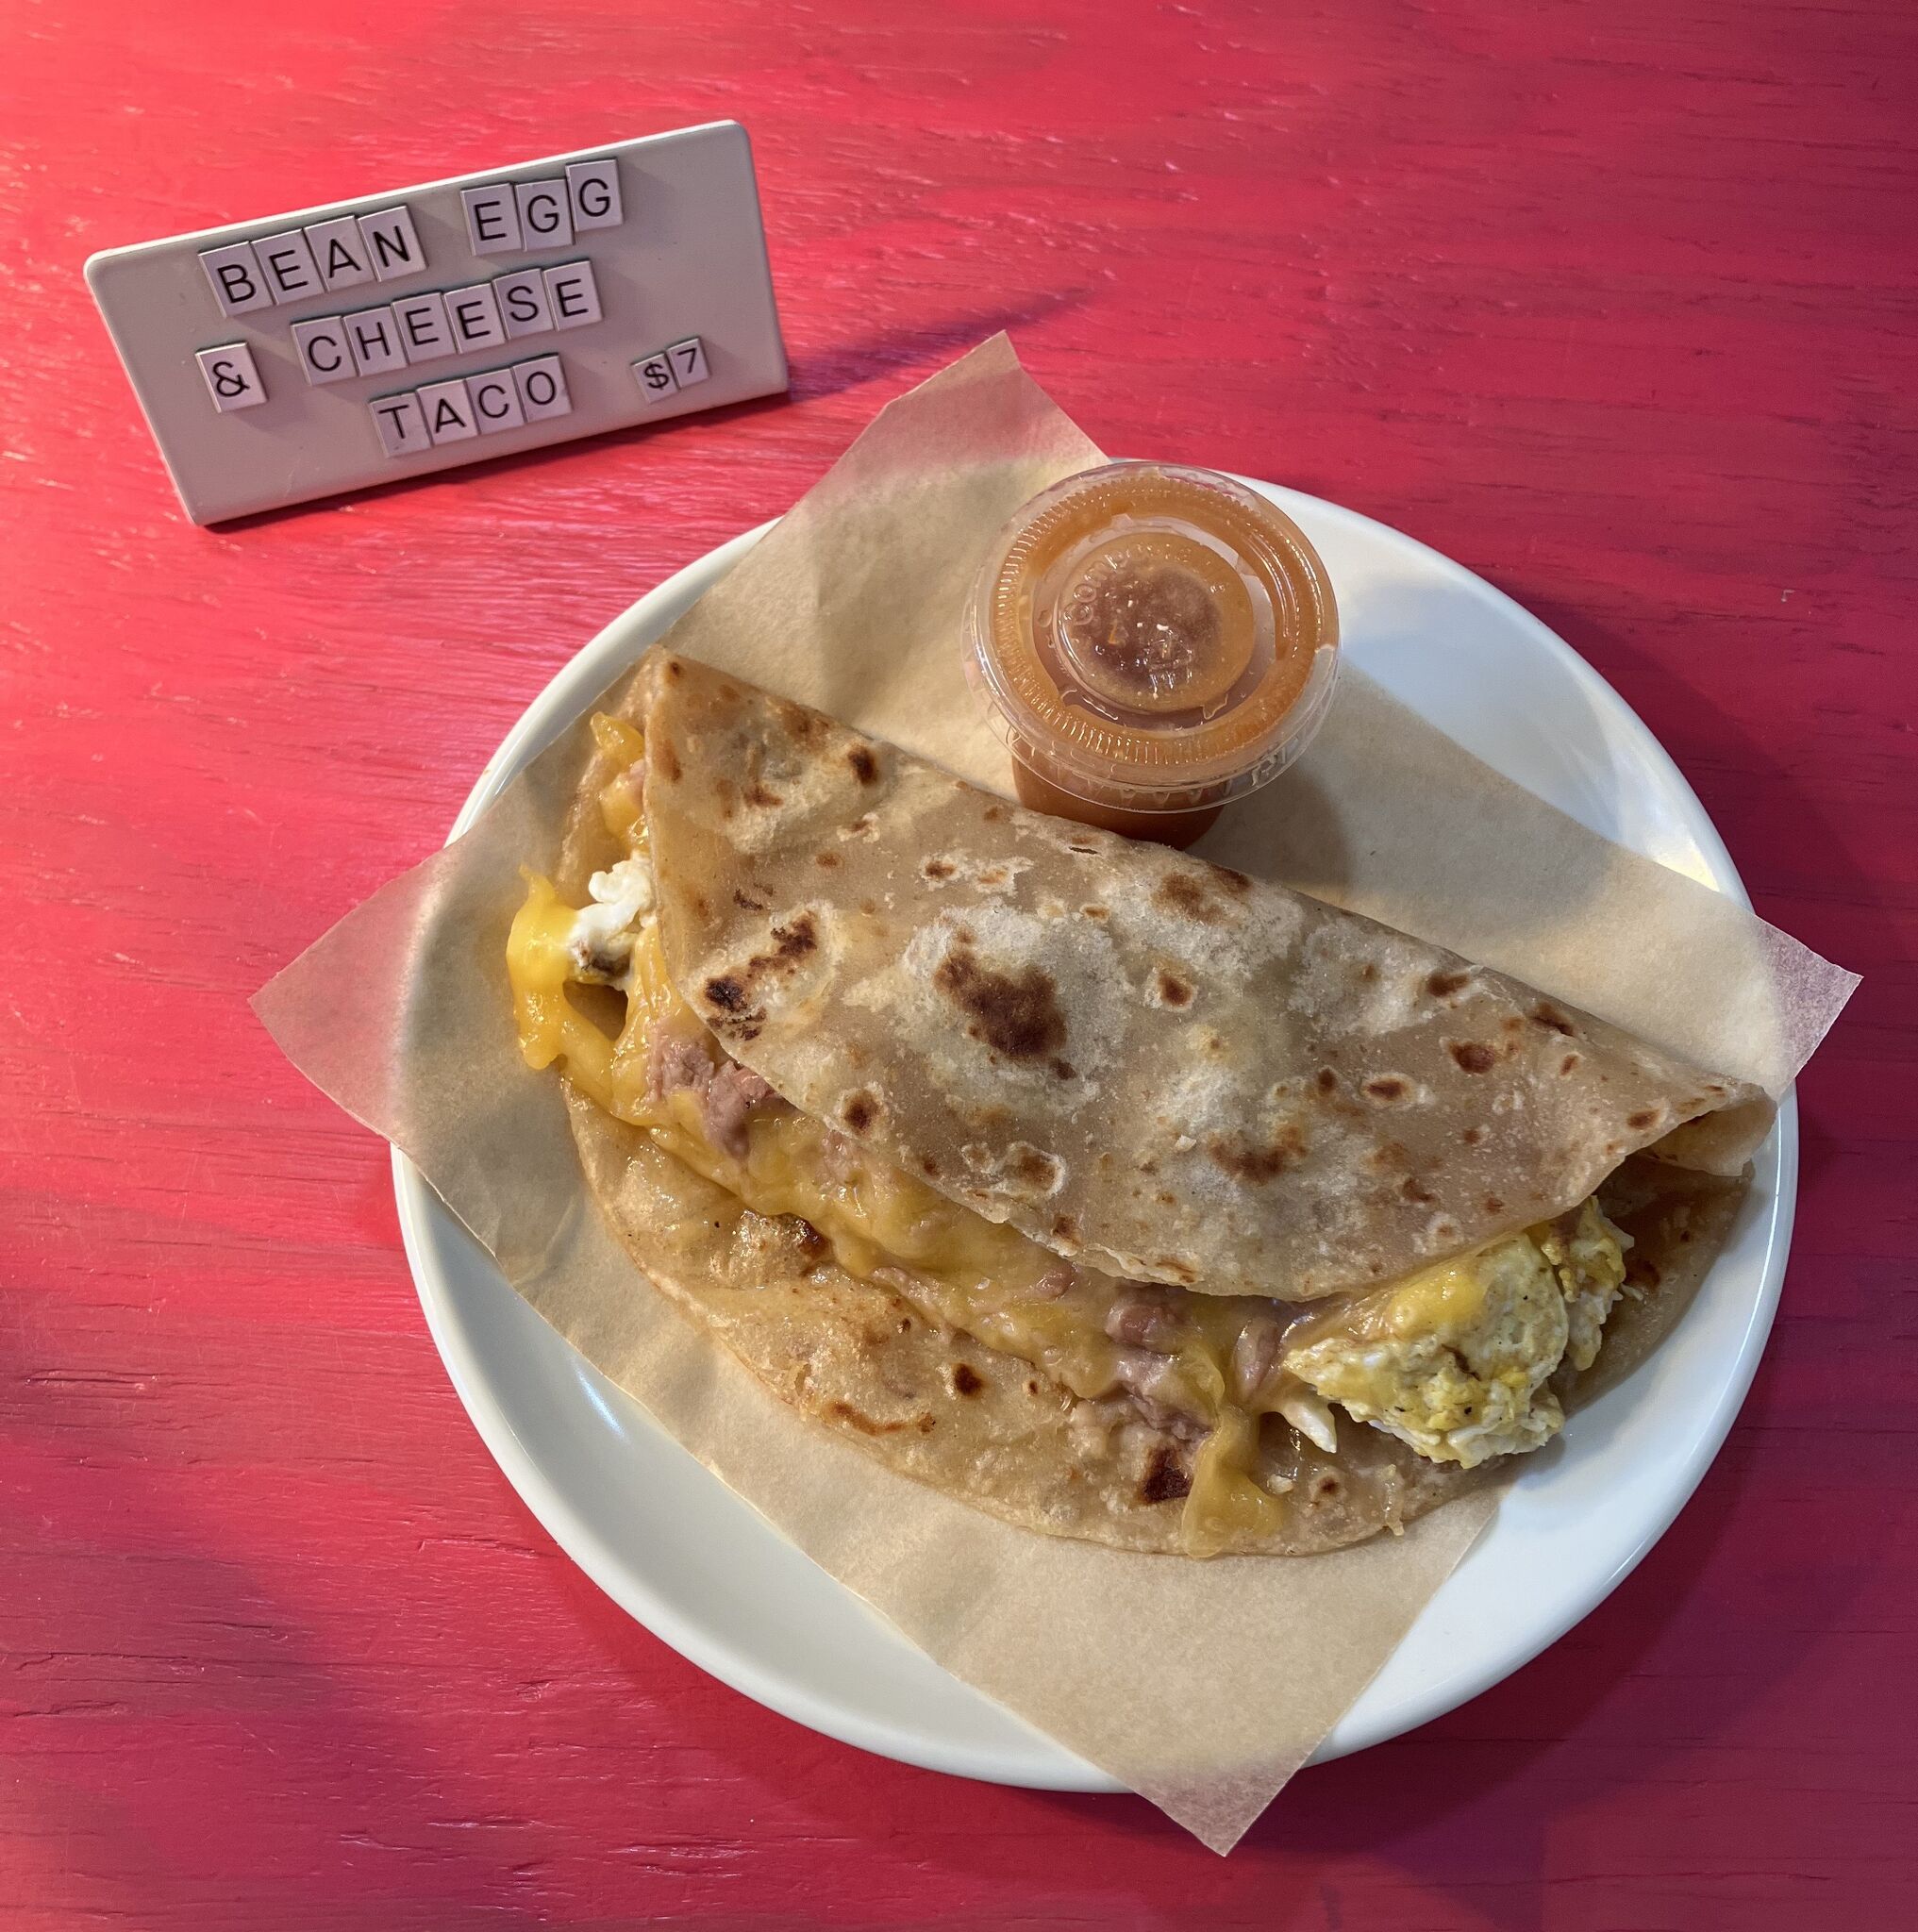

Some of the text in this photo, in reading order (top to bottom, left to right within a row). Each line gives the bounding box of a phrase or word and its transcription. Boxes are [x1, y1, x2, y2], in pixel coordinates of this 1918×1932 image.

[216, 177, 611, 305] BEAN EGG
[212, 278, 590, 398] & CHEESE
[377, 347, 698, 441] TACO $7
